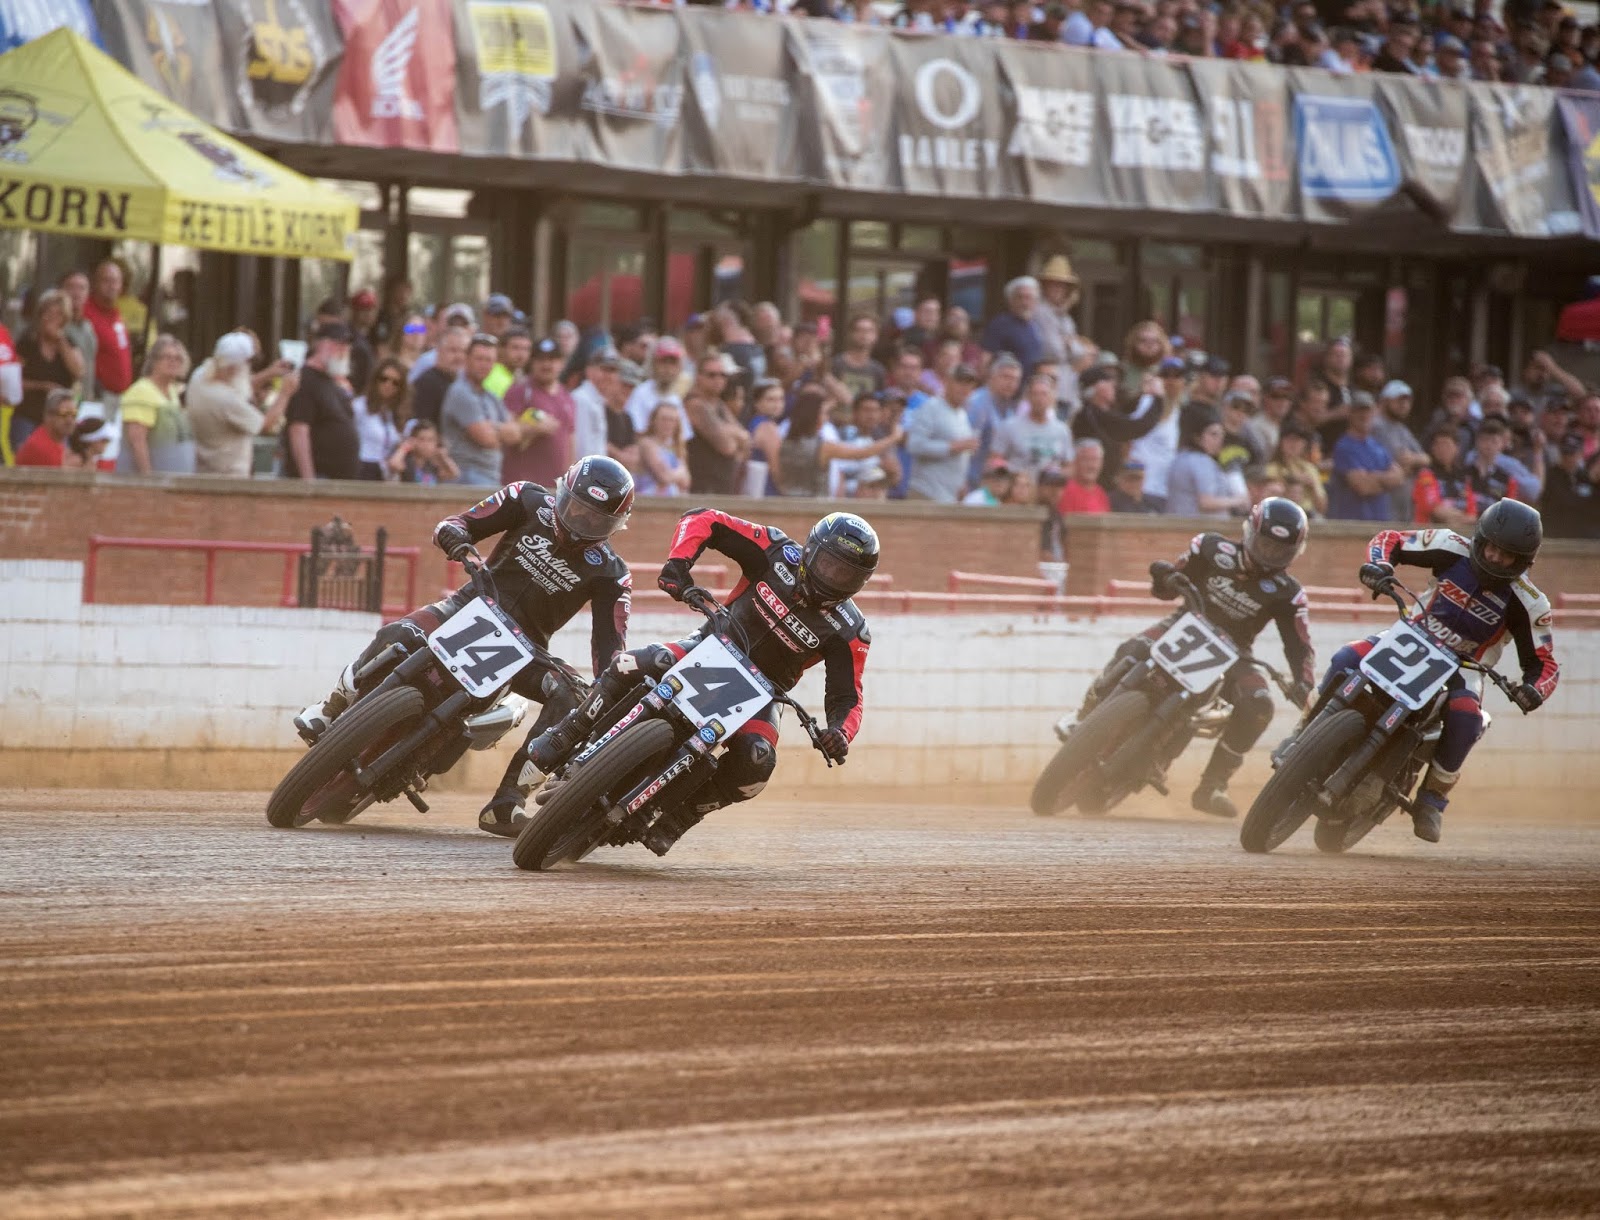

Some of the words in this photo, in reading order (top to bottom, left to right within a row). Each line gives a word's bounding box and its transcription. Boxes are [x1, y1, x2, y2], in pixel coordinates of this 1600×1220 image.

[179, 201, 275, 246] KETTLE
[590, 488, 606, 499] BELL
[515, 541, 554, 577] MOTORCYCLE
[550, 573, 574, 592] RACING
[521, 534, 581, 584] Indian
[776, 564, 793, 583] SHOEI
[435, 615, 524, 687] 14
[616, 653, 639, 674] 4
[1157, 625, 1232, 674] 37
[1365, 633, 1454, 702] 21
[678, 667, 762, 718] 4
